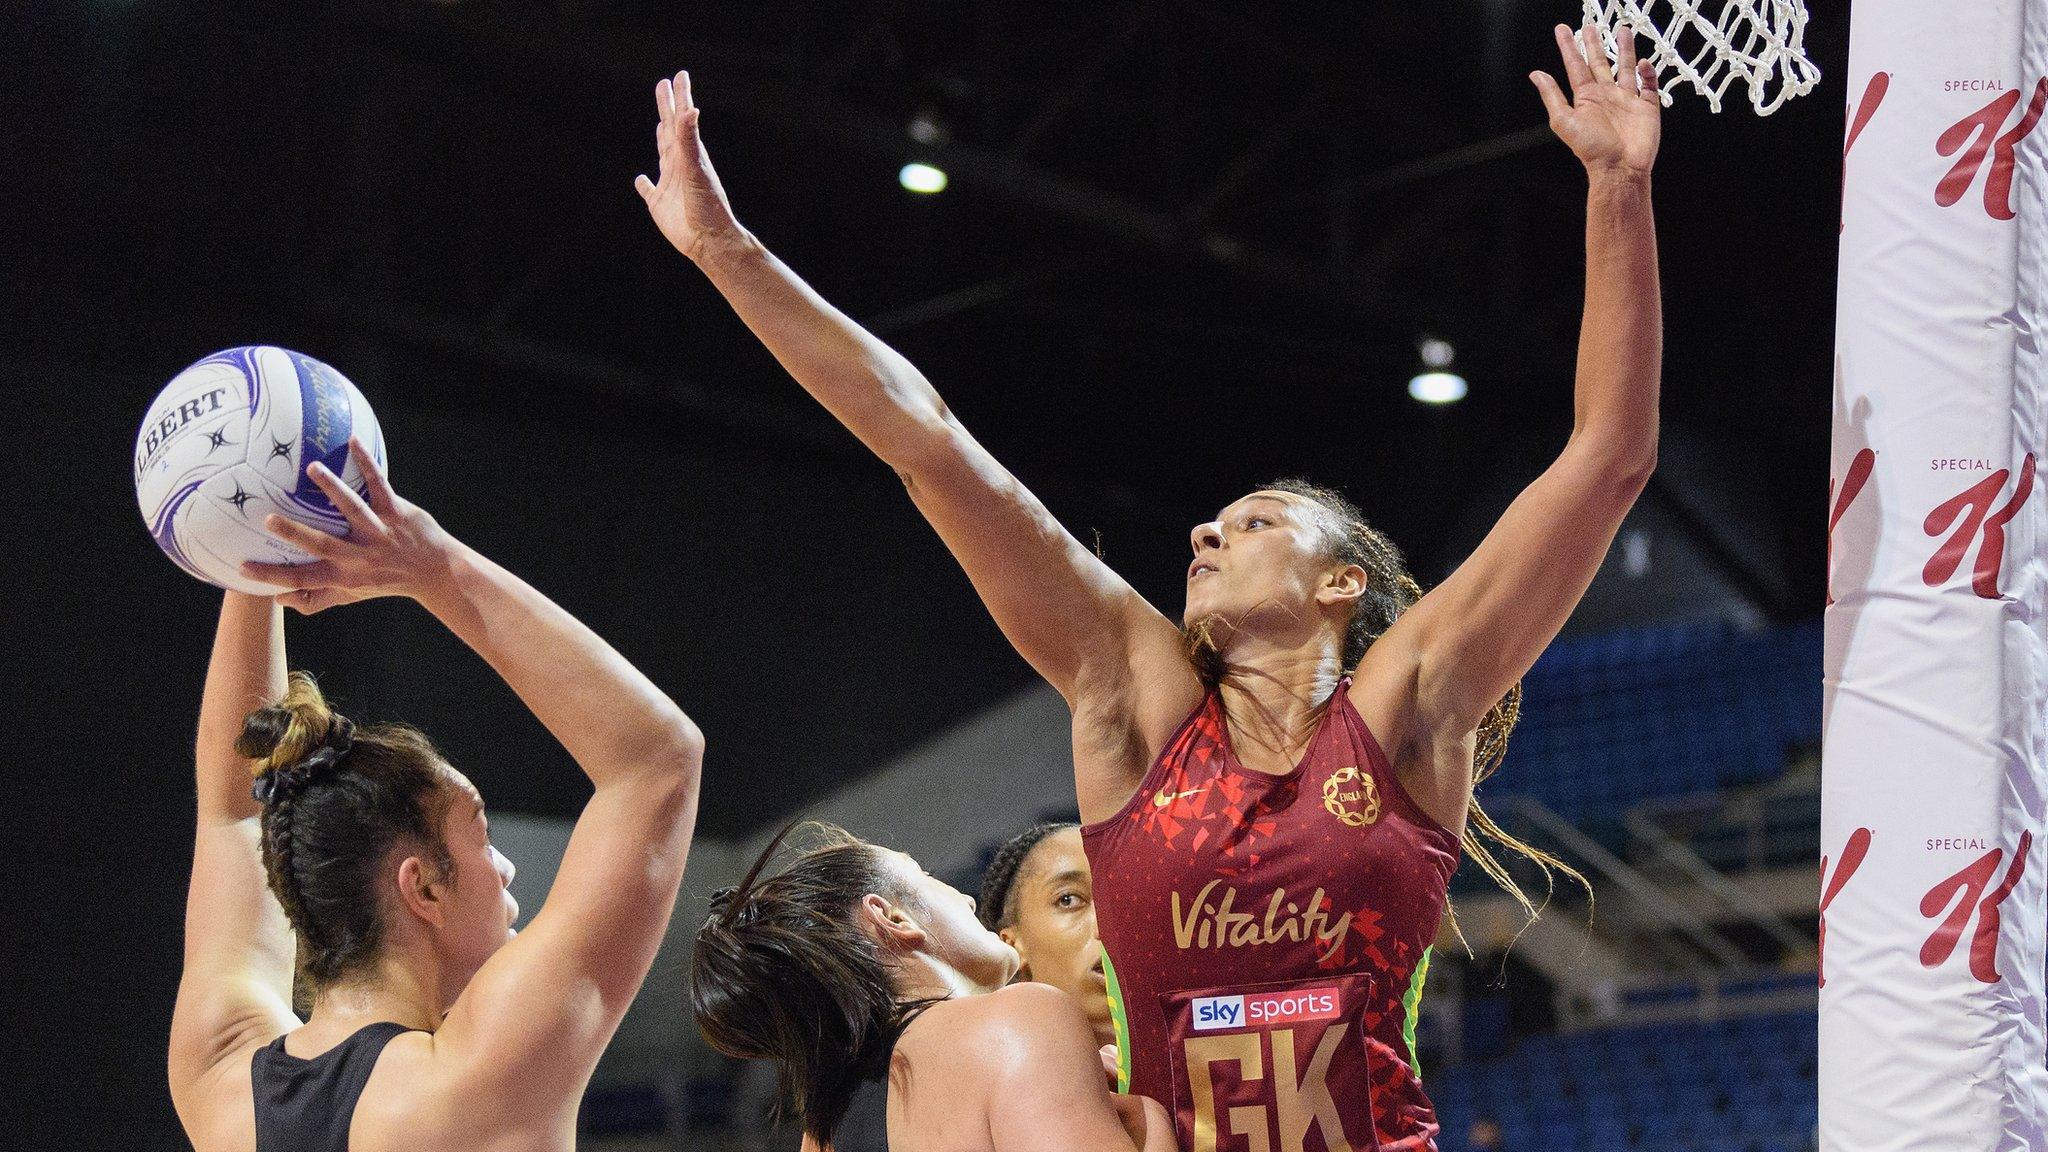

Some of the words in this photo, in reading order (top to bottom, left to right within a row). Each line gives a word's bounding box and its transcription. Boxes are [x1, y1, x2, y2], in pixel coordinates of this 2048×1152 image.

[1944, 80, 2003, 91] SPECIAL
[137, 387, 226, 474] LBERT
[1931, 459, 1992, 470] SPECIAL
[1922, 452, 2037, 600] K
[1926, 838, 1986, 850] SPECIAL
[1171, 878, 1354, 963] Vitality
[1919, 828, 2033, 983] K
[1199, 1000, 1240, 1025] sky
[1250, 993, 1334, 1022] sports
[1183, 1022, 1351, 1152] GK
